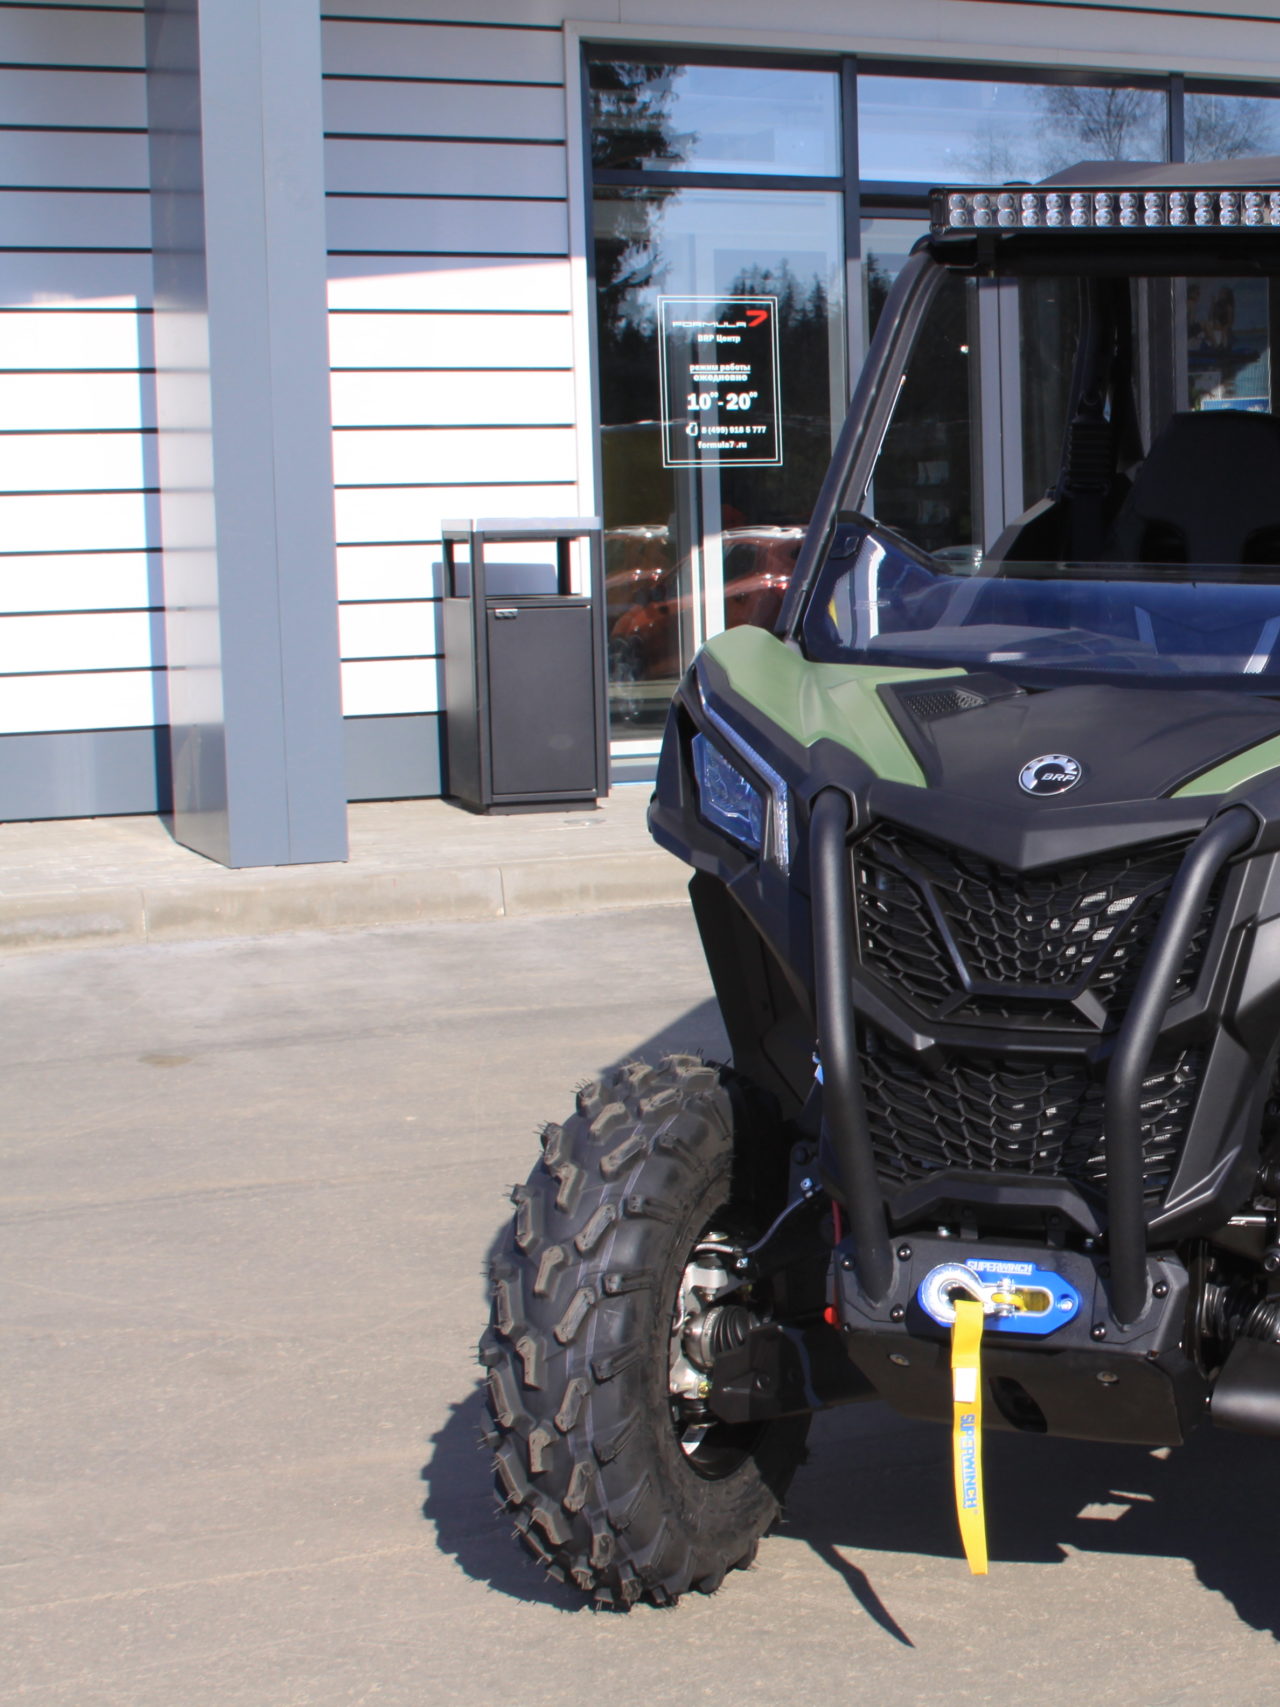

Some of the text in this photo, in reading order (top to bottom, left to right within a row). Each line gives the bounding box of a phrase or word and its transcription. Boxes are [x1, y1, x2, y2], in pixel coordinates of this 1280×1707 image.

[716, 334, 741, 343] Центр
[689, 362, 751, 373] режим работы
[1041, 772, 1076, 782] BRP
[966, 1260, 1033, 1275] SUPERWINCH
[959, 1413, 978, 1509] SUPERWINCH
